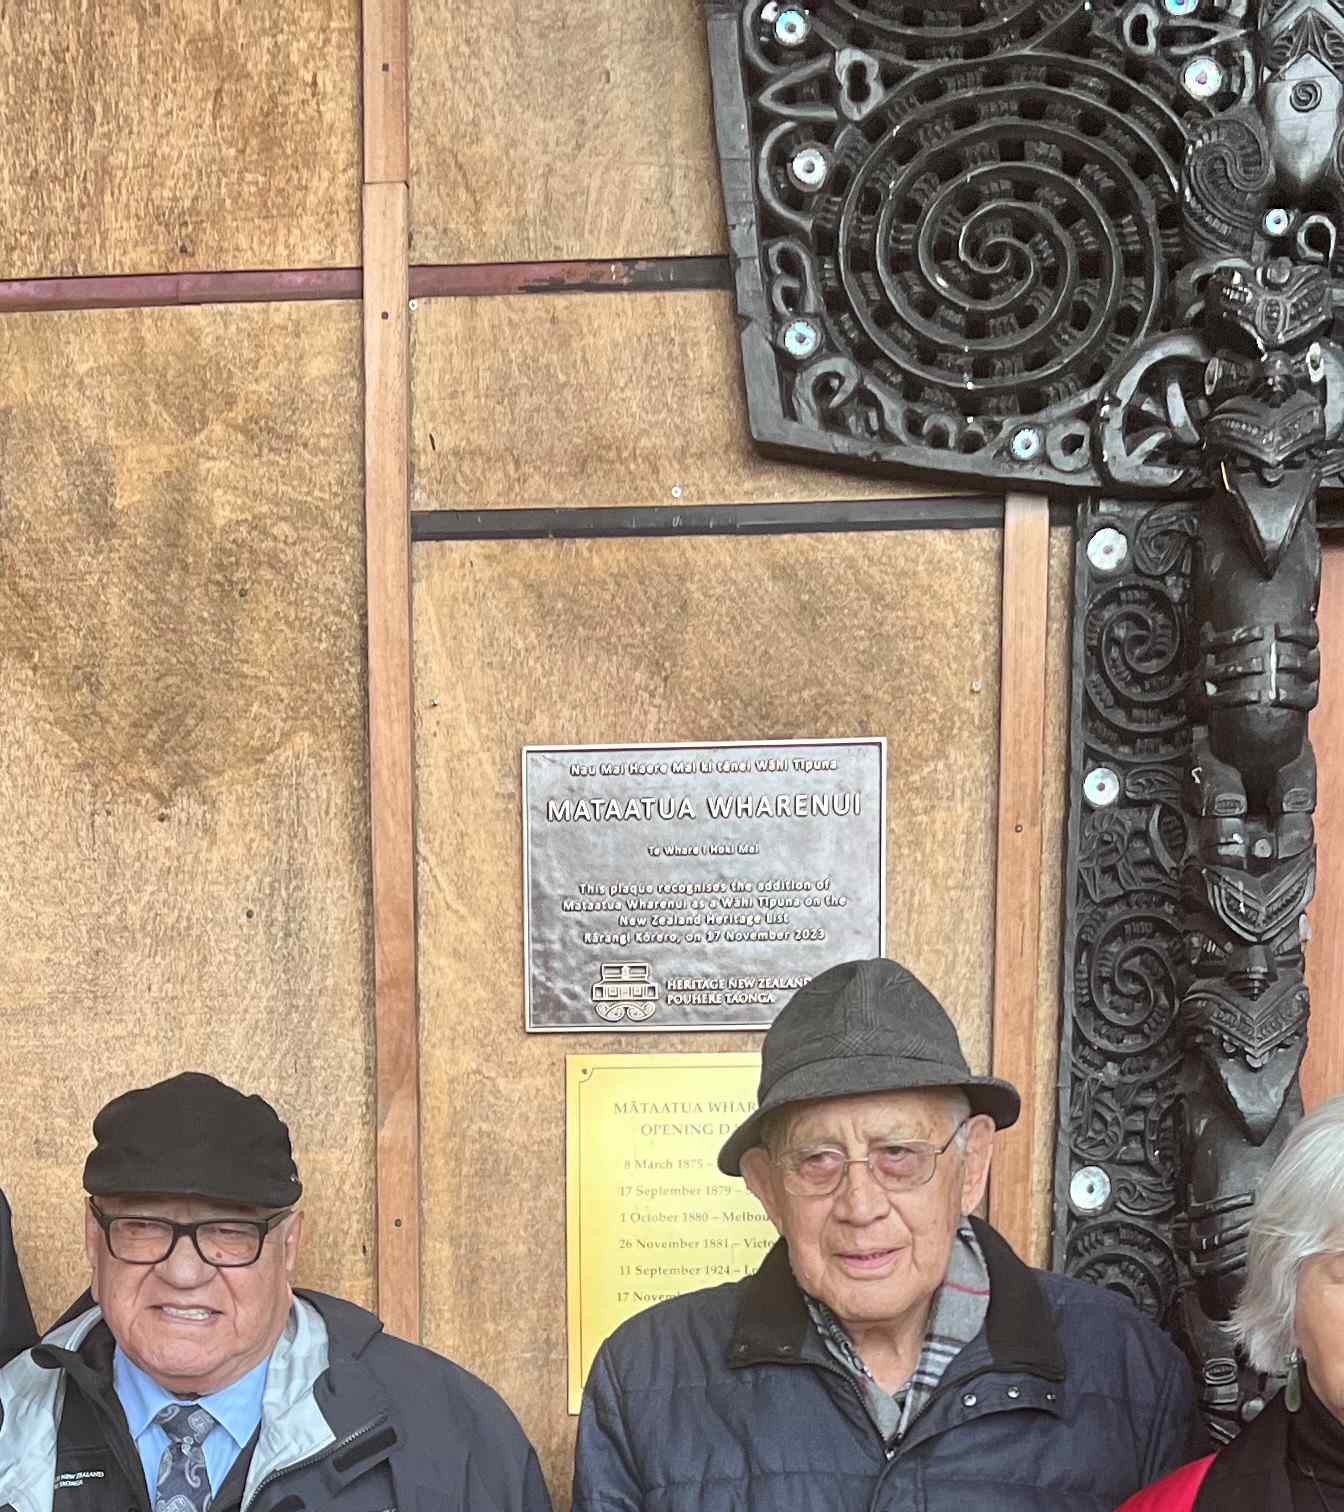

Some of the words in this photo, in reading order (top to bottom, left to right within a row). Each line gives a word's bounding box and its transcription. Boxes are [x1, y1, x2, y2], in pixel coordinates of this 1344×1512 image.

[570, 763, 596, 776] Nau
[600, 763, 625, 775] Mai
[628, 762, 667, 775] Haere
[672, 761, 696, 774] Mai
[547, 797, 697, 822] MATAATUA
[706, 792, 862, 819] WHARENUI
[663, 844, 699, 856] Whare
[579, 883, 605, 895] This
[609, 883, 653, 897] plaque
[657, 880, 726, 895] recognises
[730, 880, 752, 892] the
[757, 879, 811, 891] addition
[815, 878, 831, 891] of
[562, 899, 622, 912] Mataatua
[626, 898, 687, 911] Wharenui
[691, 899, 705, 910] as
[804, 896, 821, 907] on
[824, 895, 848, 907] the
[618, 915, 646, 926] New
[651, 913, 702, 926] Zealand
[705, 911, 761, 927] Heritage
[765, 912, 790, 924] List
[685, 932, 702, 944] on
[706, 930, 720, 942] 17
[725, 929, 790, 942] November
[793, 928, 825, 941] 2023
[667, 977, 725, 990] HERITAGE
[728, 976, 755, 989] NEW
[667, 992, 722, 1005] POUHERE
[725, 991, 776, 1004] TAONGA
[640, 1122, 714, 1136] OPENING
[634, 1158, 673, 1170] March
[636, 1185, 701, 1200] September
[706, 1185, 732, 1196] 1879
[630, 1211, 678, 1223] October
[683, 1212, 709, 1223] 1880
[619, 1238, 632, 1249] 26
[636, 1237, 699, 1249] November
[703, 1239, 729, 1249] 1881
[620, 1265, 631, 1276] 11
[635, 1264, 701, 1279] September
[706, 1264, 731, 1275] 1924
[617, 1291, 629, 1302] 17
